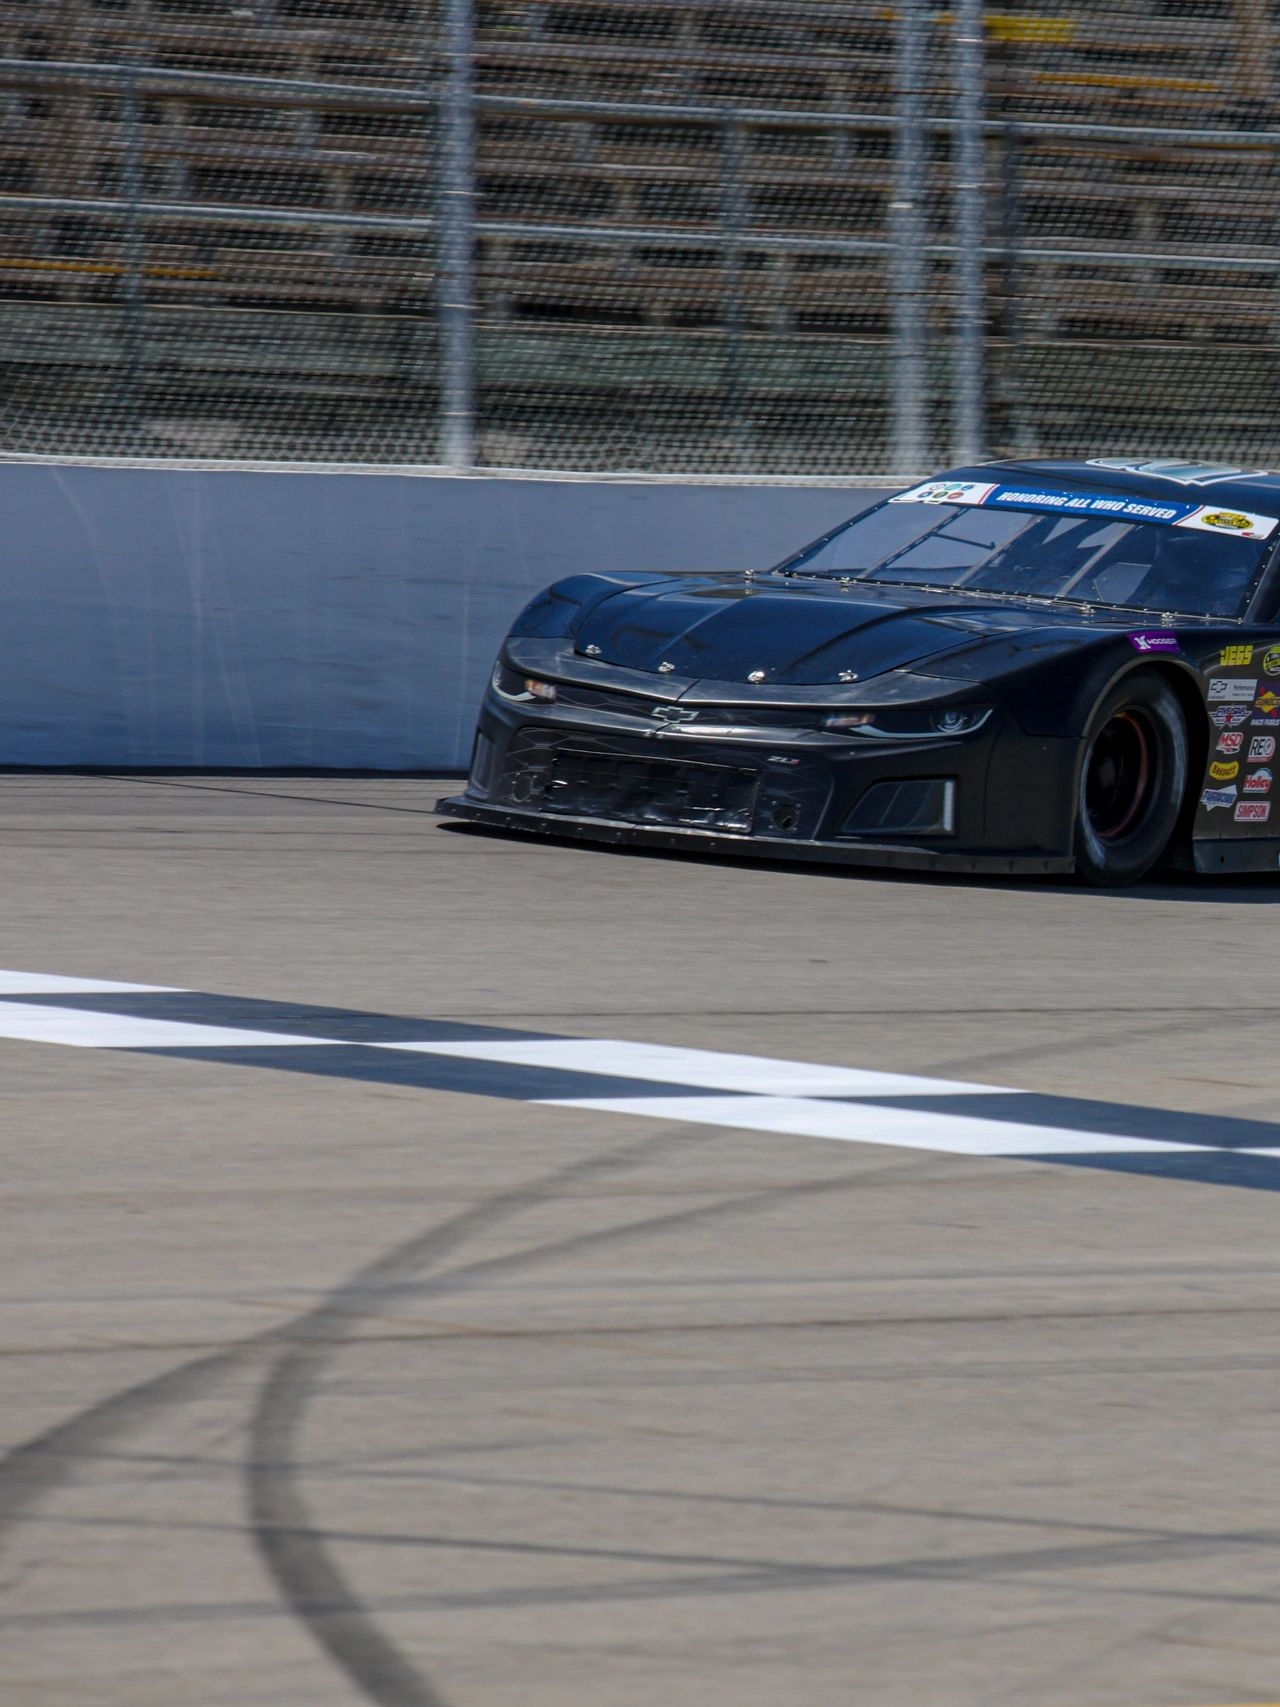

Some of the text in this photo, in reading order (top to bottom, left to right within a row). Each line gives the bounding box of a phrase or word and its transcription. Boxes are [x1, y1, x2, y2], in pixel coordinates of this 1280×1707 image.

[996, 491, 1178, 519] HONORING ALL WHO SERVED
[1219, 645, 1254, 666] JEGS
[1220, 734, 1242, 746] MSD
[1246, 775, 1270, 791] Holley
[1237, 805, 1269, 818] SIMPSON
